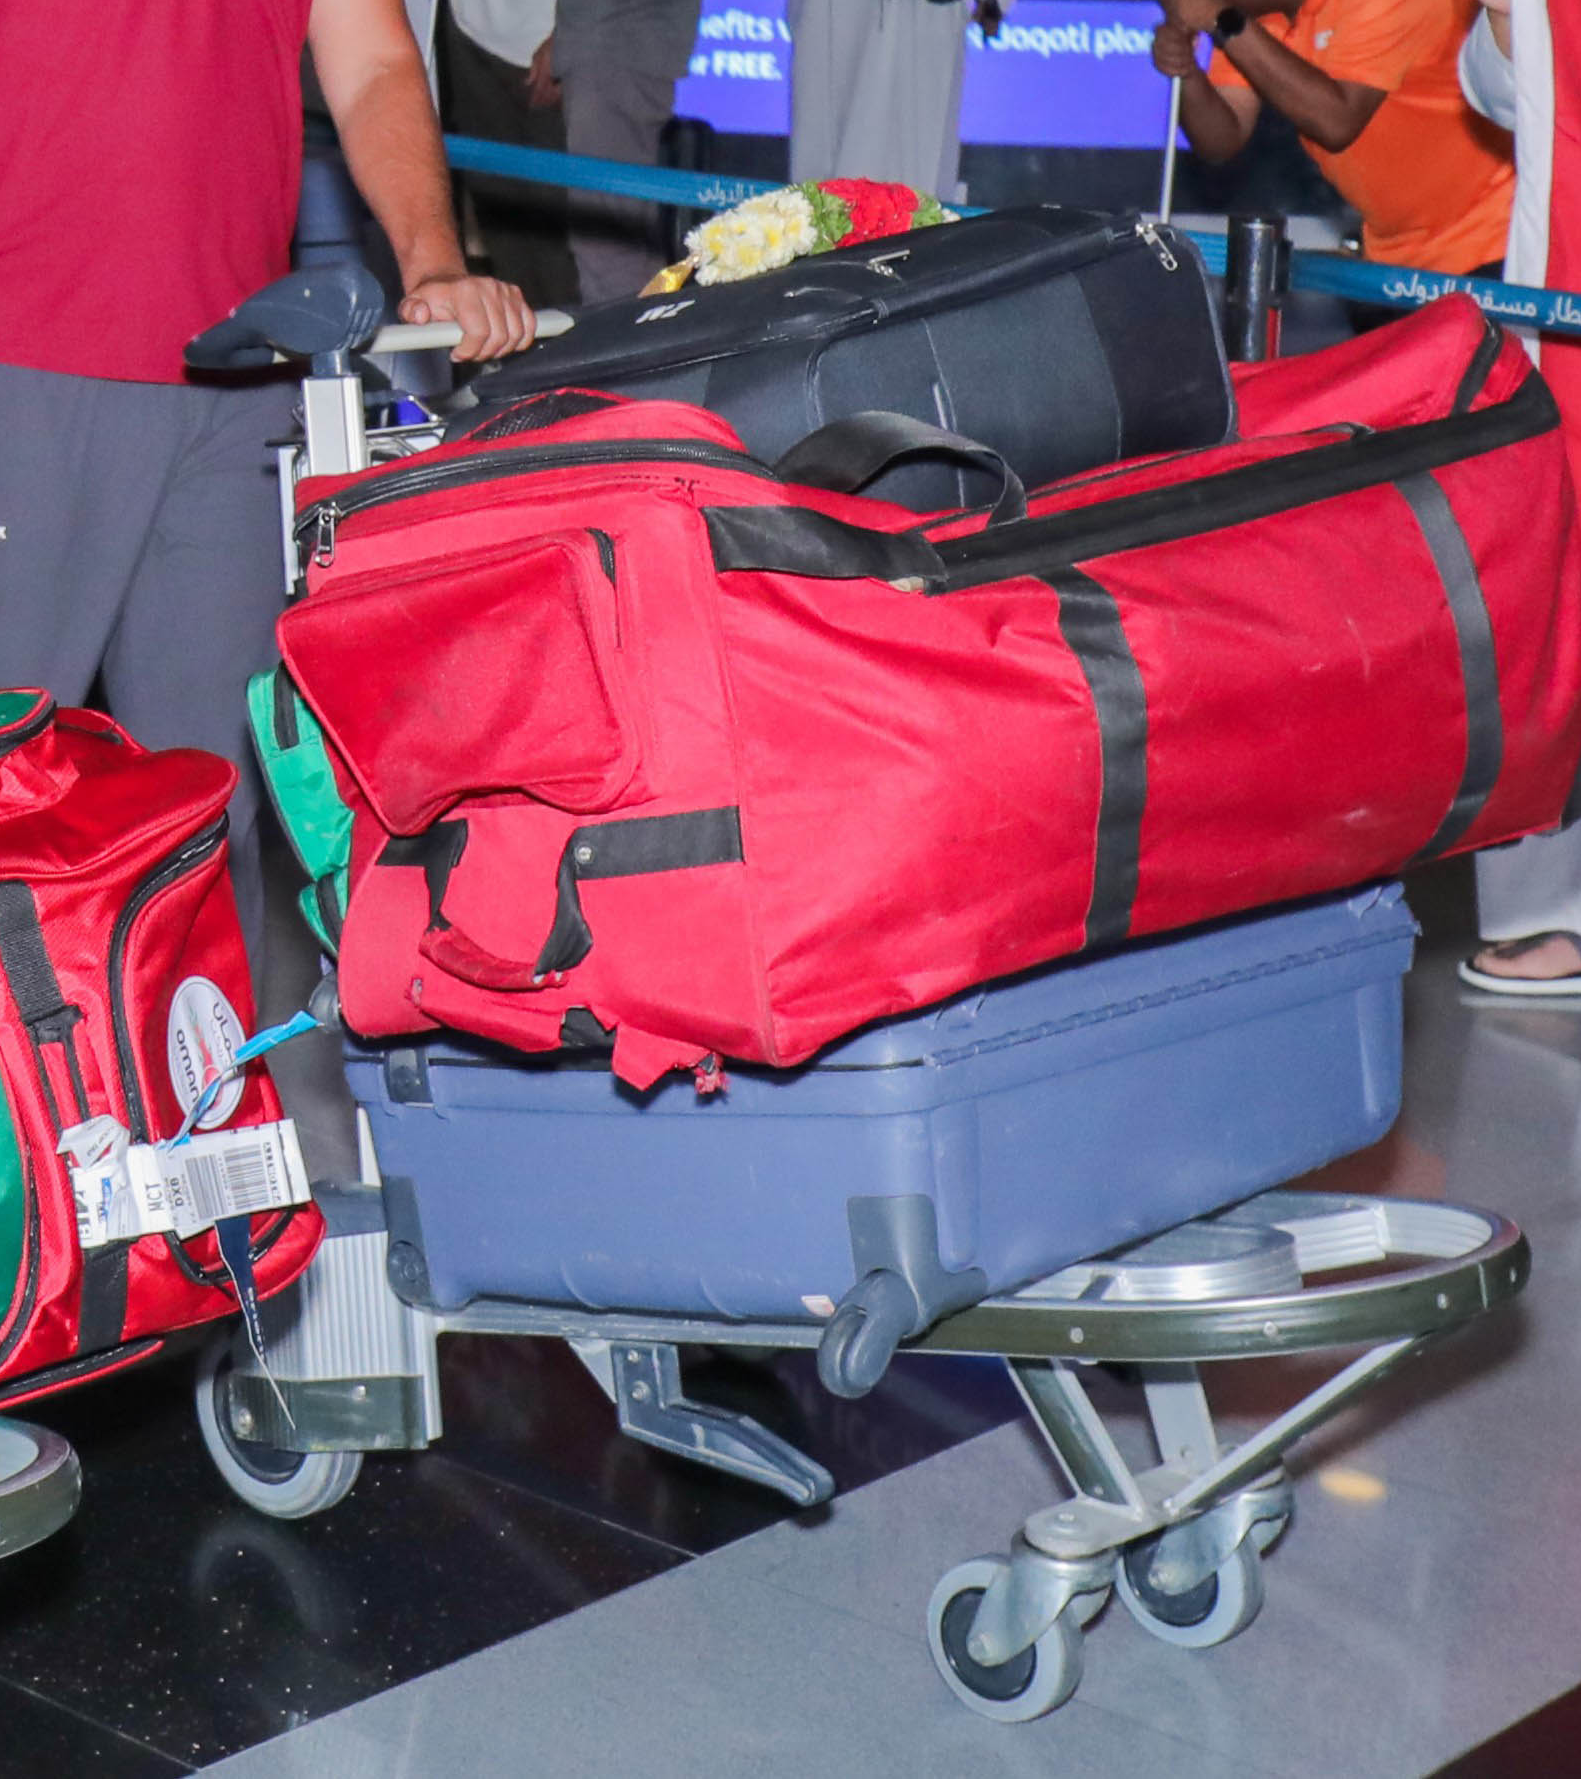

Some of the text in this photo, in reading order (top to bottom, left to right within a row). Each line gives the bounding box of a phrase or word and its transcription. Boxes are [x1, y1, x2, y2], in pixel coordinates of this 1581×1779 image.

[699, 7, 775, 42] efits
[712, 50, 783, 81] FREE.
[144, 1181, 164, 1214] MCT
